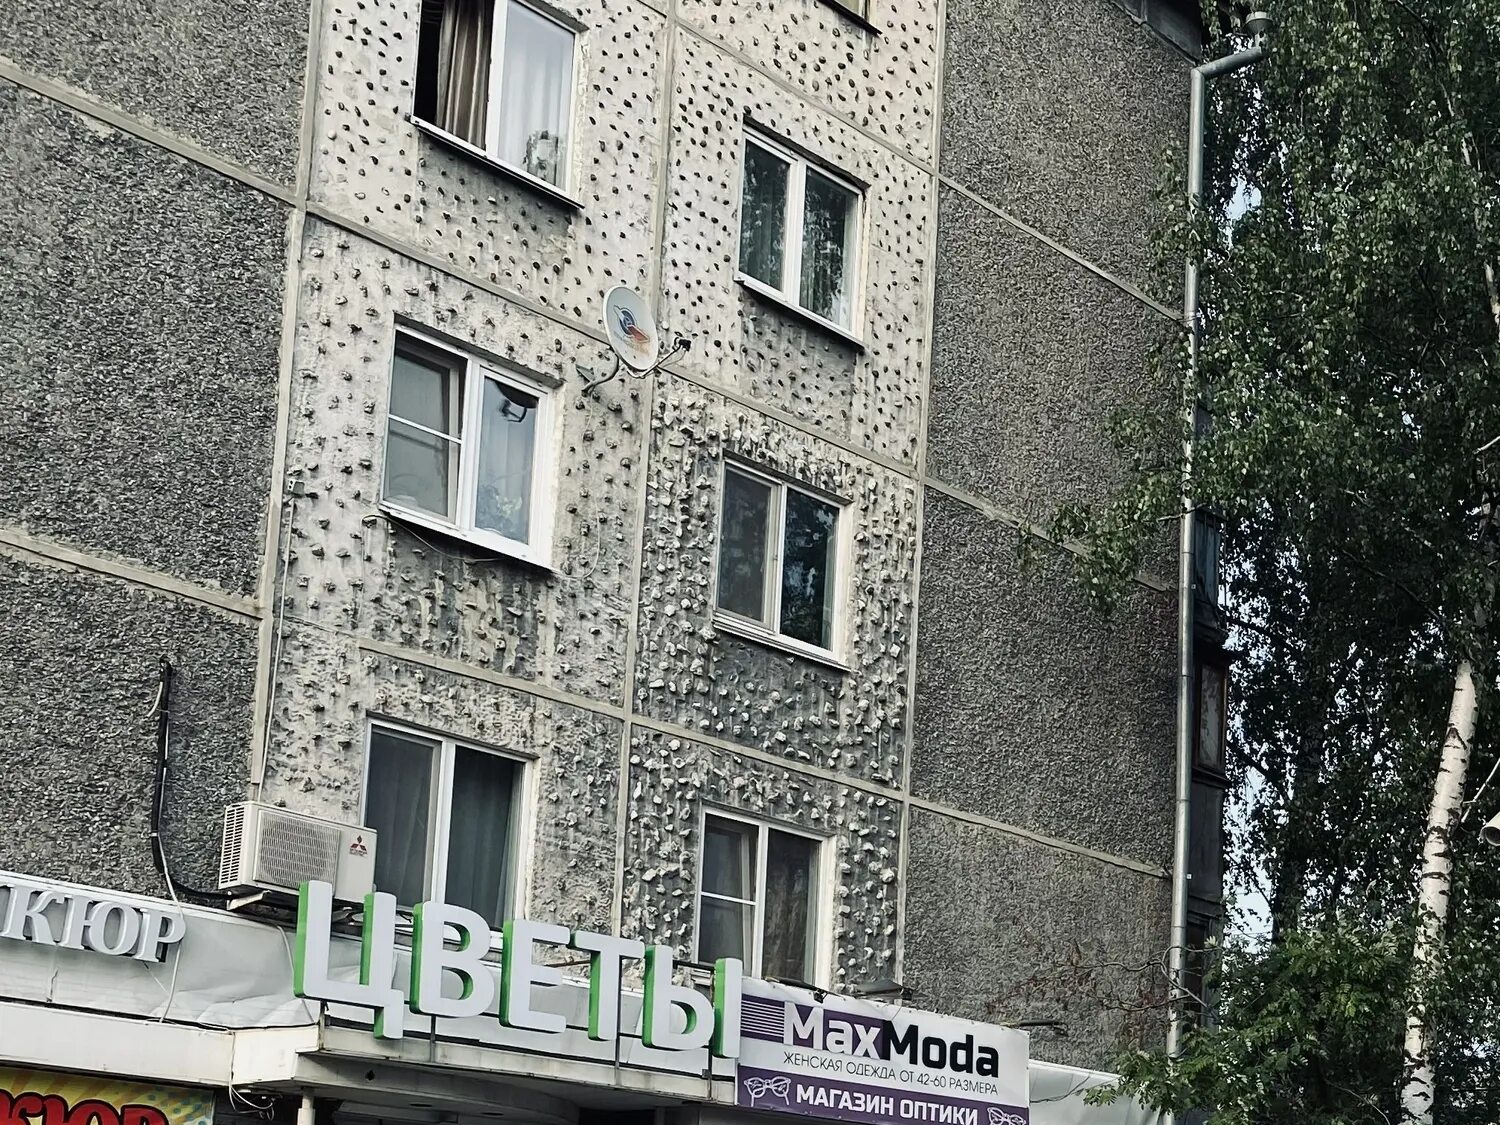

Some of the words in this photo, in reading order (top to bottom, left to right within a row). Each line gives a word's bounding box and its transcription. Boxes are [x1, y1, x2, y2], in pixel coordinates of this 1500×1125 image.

[293, 879, 743, 1059] ЦВЕТЫ
[784, 1000, 999, 1079] MaxModa
[783, 1051, 843, 1073] ЖЕНСКАЯ
[846, 1061, 896, 1081] ОДЕЖДА
[900, 1069, 916, 1084] ОТ
[917, 1072, 947, 1088] 42-60
[950, 1077, 999, 1096] РАЗМЕРА
[796, 1084, 893, 1117] МАГАЗИН
